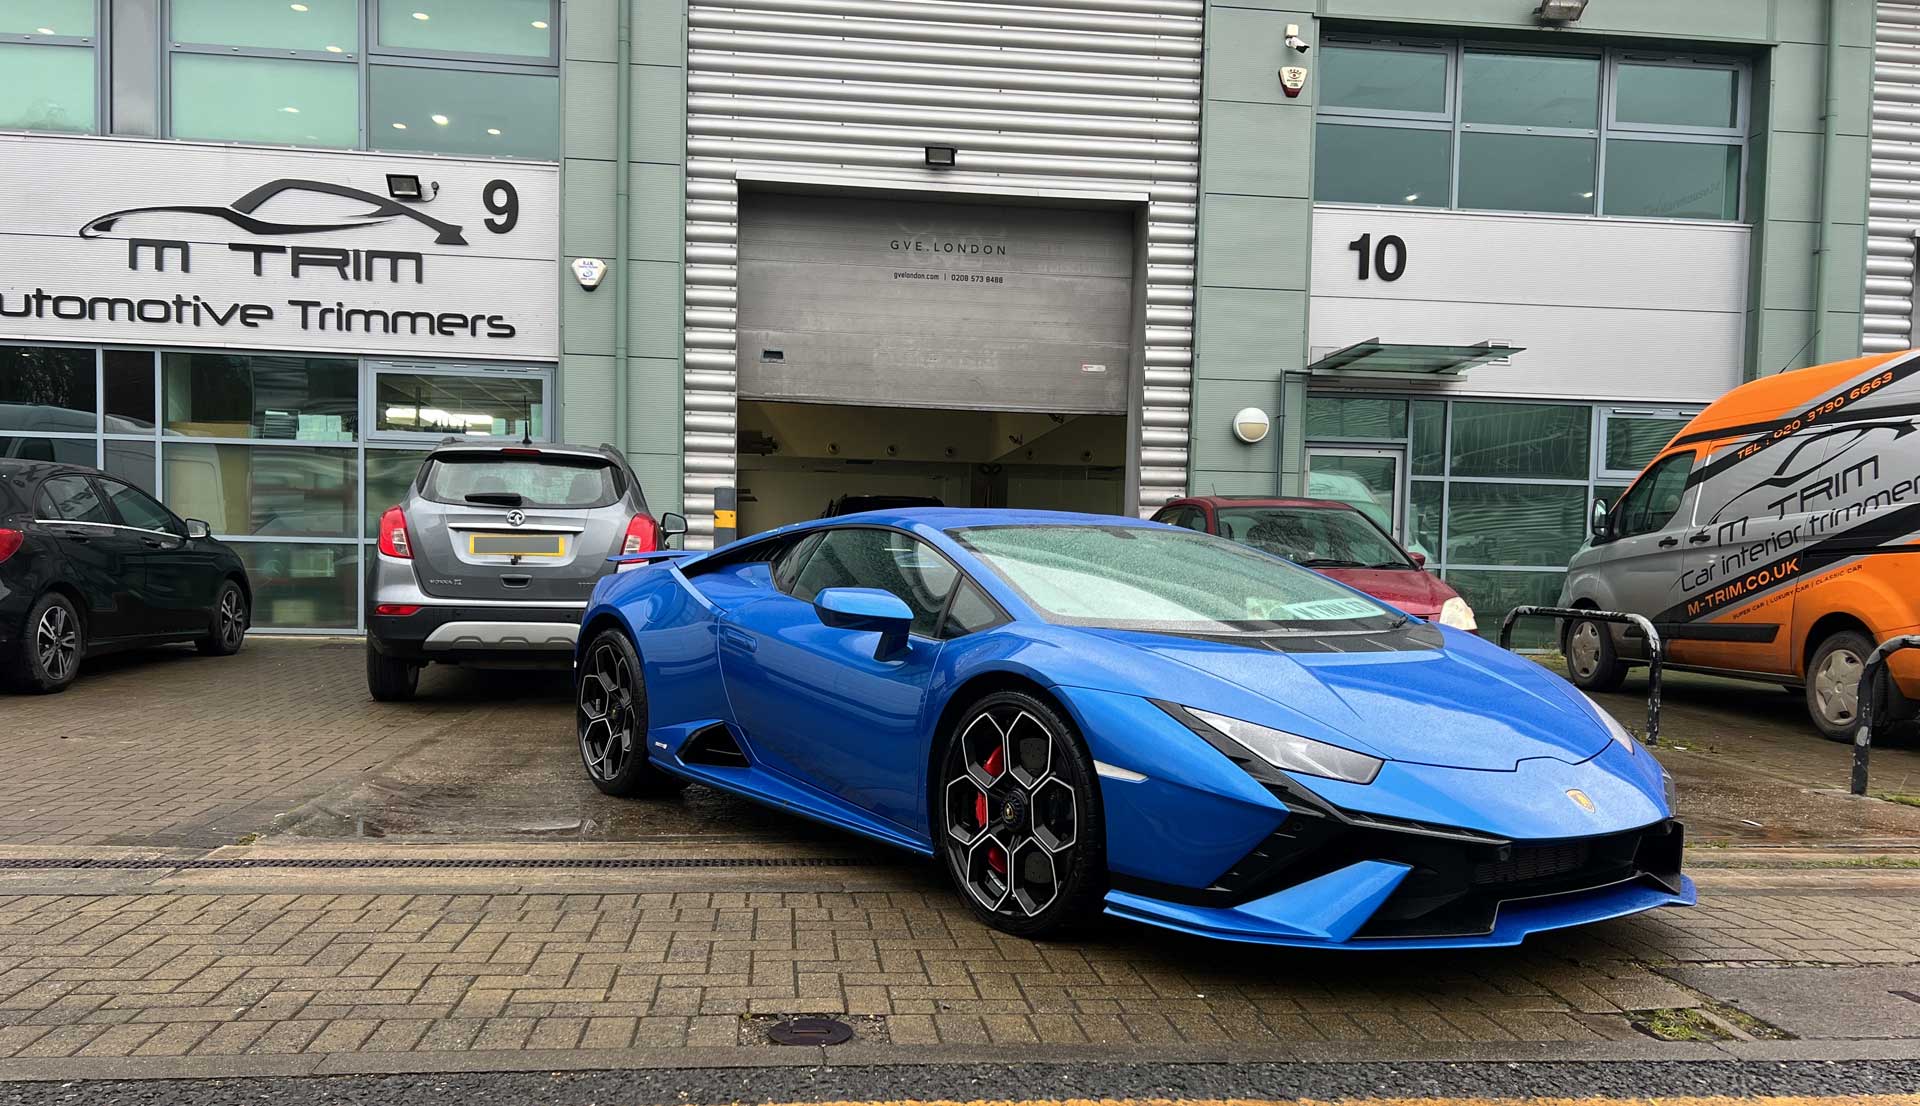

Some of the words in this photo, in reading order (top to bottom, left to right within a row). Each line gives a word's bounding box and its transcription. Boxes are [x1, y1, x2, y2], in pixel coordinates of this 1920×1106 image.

[483, 179, 519, 234] 9
[1349, 233, 1407, 282] 10
[287, 300, 516, 339] Trimmers
[1737, 443, 1762, 460] TEL
[1773, 419, 1801, 439] 020
[1807, 396, 1845, 422] 3730
[1850, 371, 1894, 400] 6663
[1681, 563, 1716, 592] Car
[1721, 524, 1802, 575] interior
[1687, 558, 1800, 617] M-TRIM.CO.UK
[1751, 601, 1765, 612] CAR
[1795, 583, 1810, 594] CAR
[1815, 570, 1845, 586] CLASSIC
[1847, 564, 1863, 574] CAR
